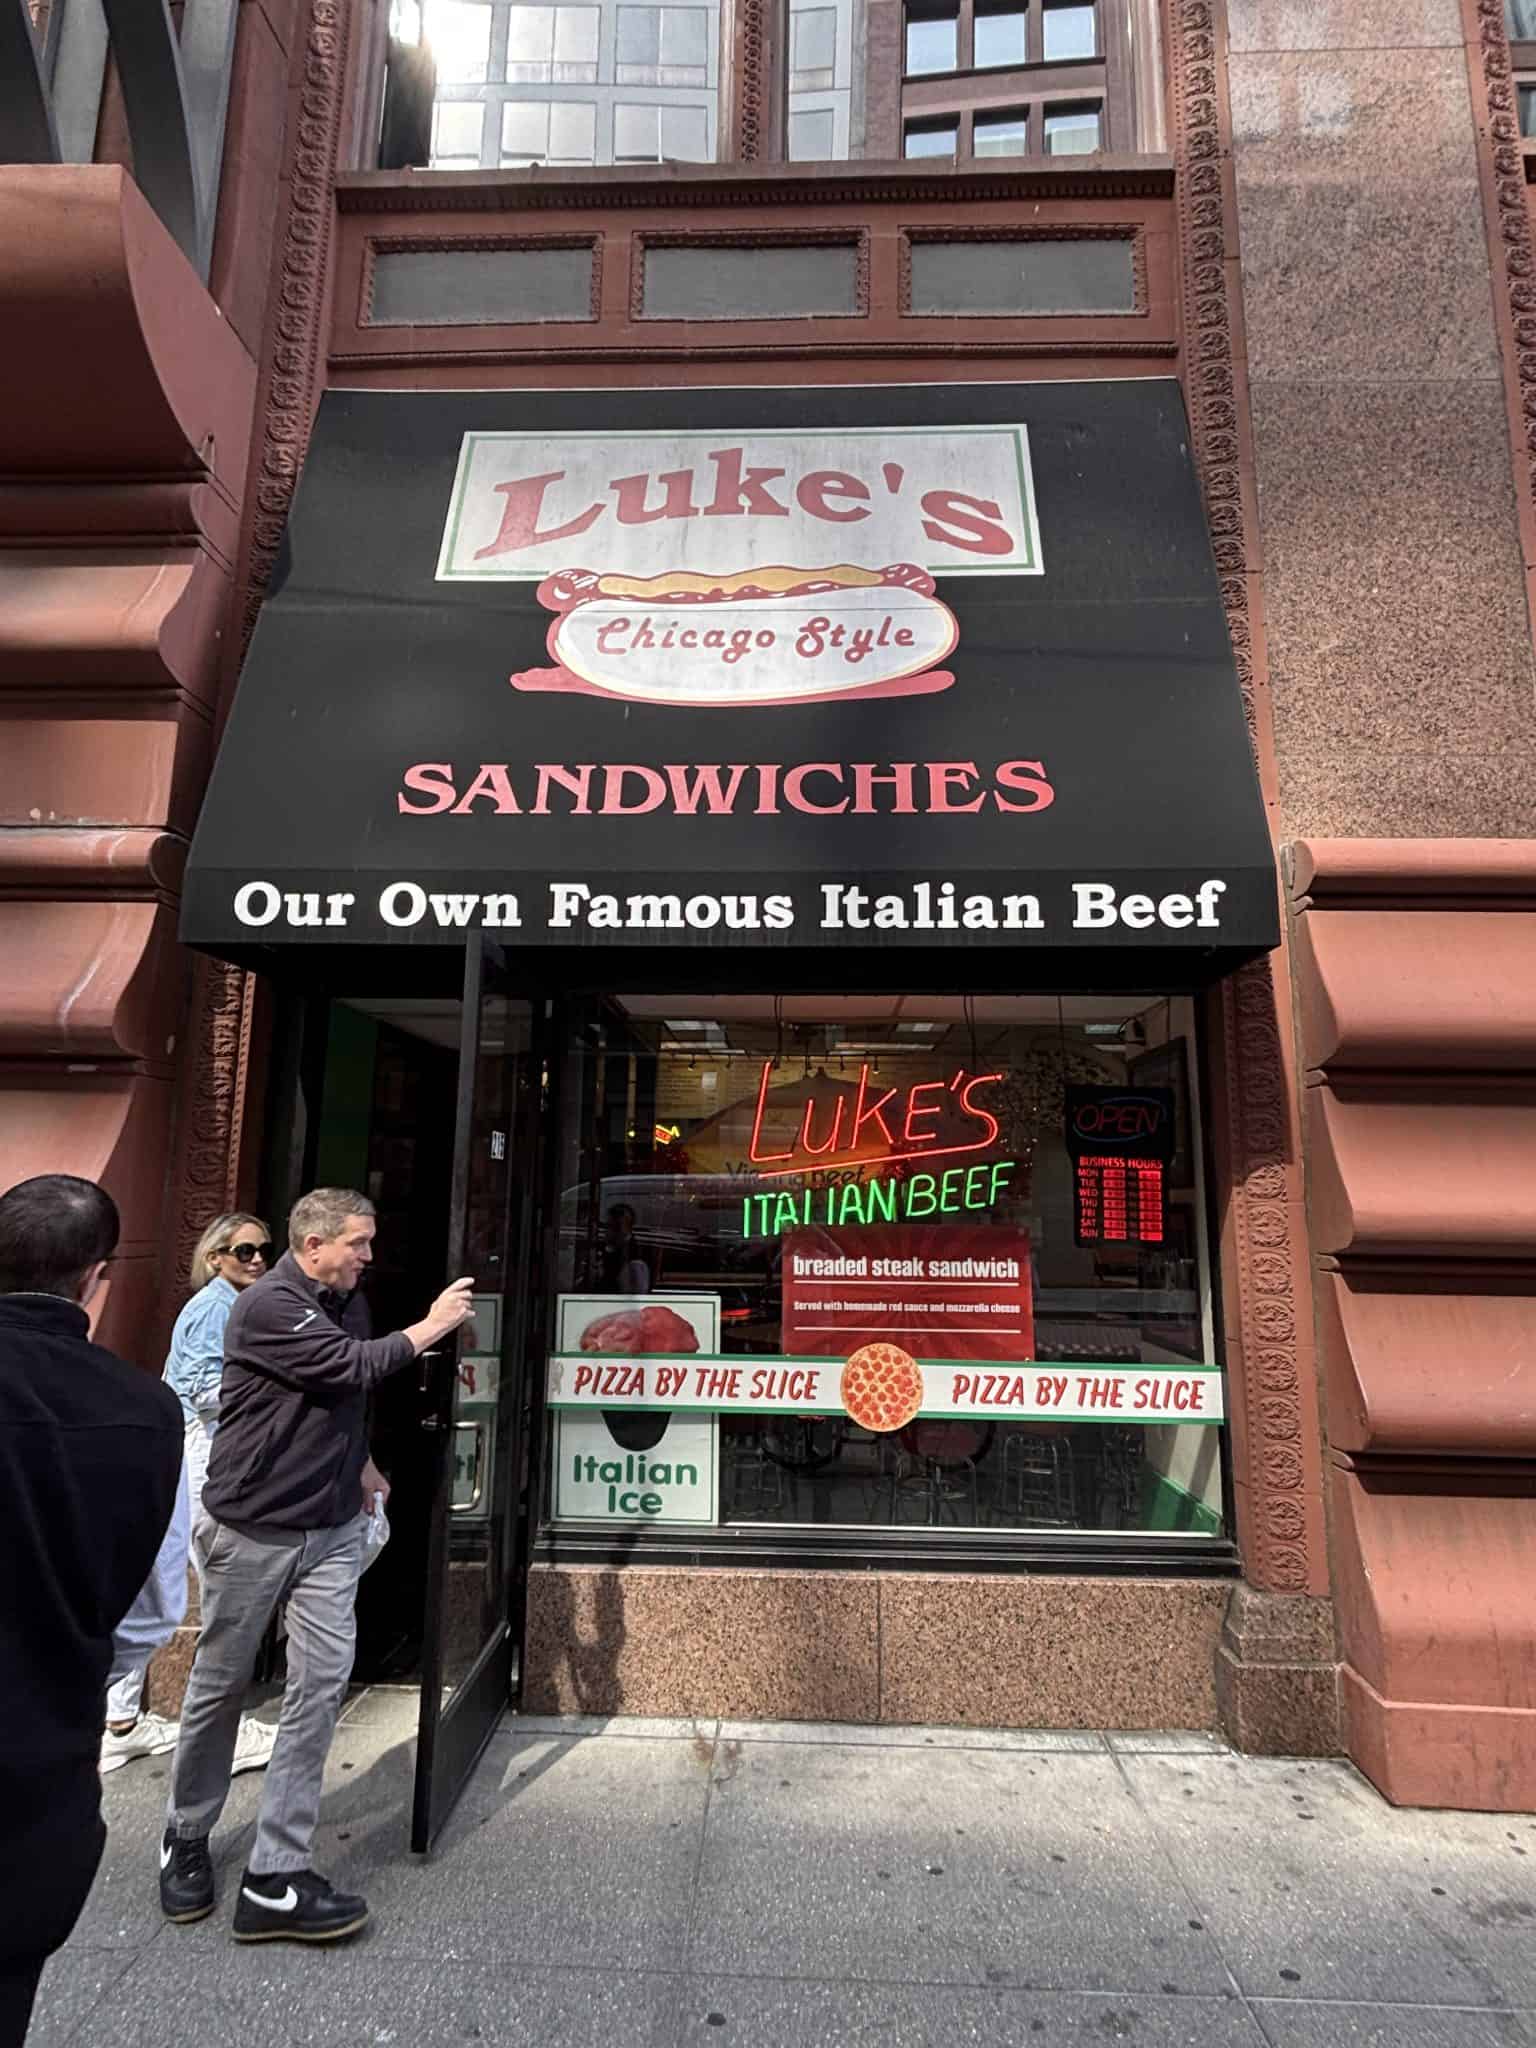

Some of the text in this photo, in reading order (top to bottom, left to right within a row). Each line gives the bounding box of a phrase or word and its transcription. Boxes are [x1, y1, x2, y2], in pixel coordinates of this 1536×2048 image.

[475, 446, 1015, 560] Luke's
[597, 617, 914, 664] Chicago Style
[396, 759, 1056, 816] SANDWICHES
[233, 878, 1227, 930] Our Own Famous Italian Beef
[1077, 1104, 1160, 1133] OPEN
[1079, 1156, 1164, 1169] BUSINESS HOURS
[743, 1162, 1014, 1238] ITALIAN BEEF
[793, 1255, 1019, 1278] breaded steak sandwich
[823, 1301, 842, 1311] with
[929, 1303, 945, 1312] and
[574, 1364, 820, 1401] PIZZA BY THE SLICE
[951, 1373, 1206, 1411] PIZZA BY THE SLICE
[572, 1455, 698, 1486] Italian
[607, 1486, 663, 1515] Ice
